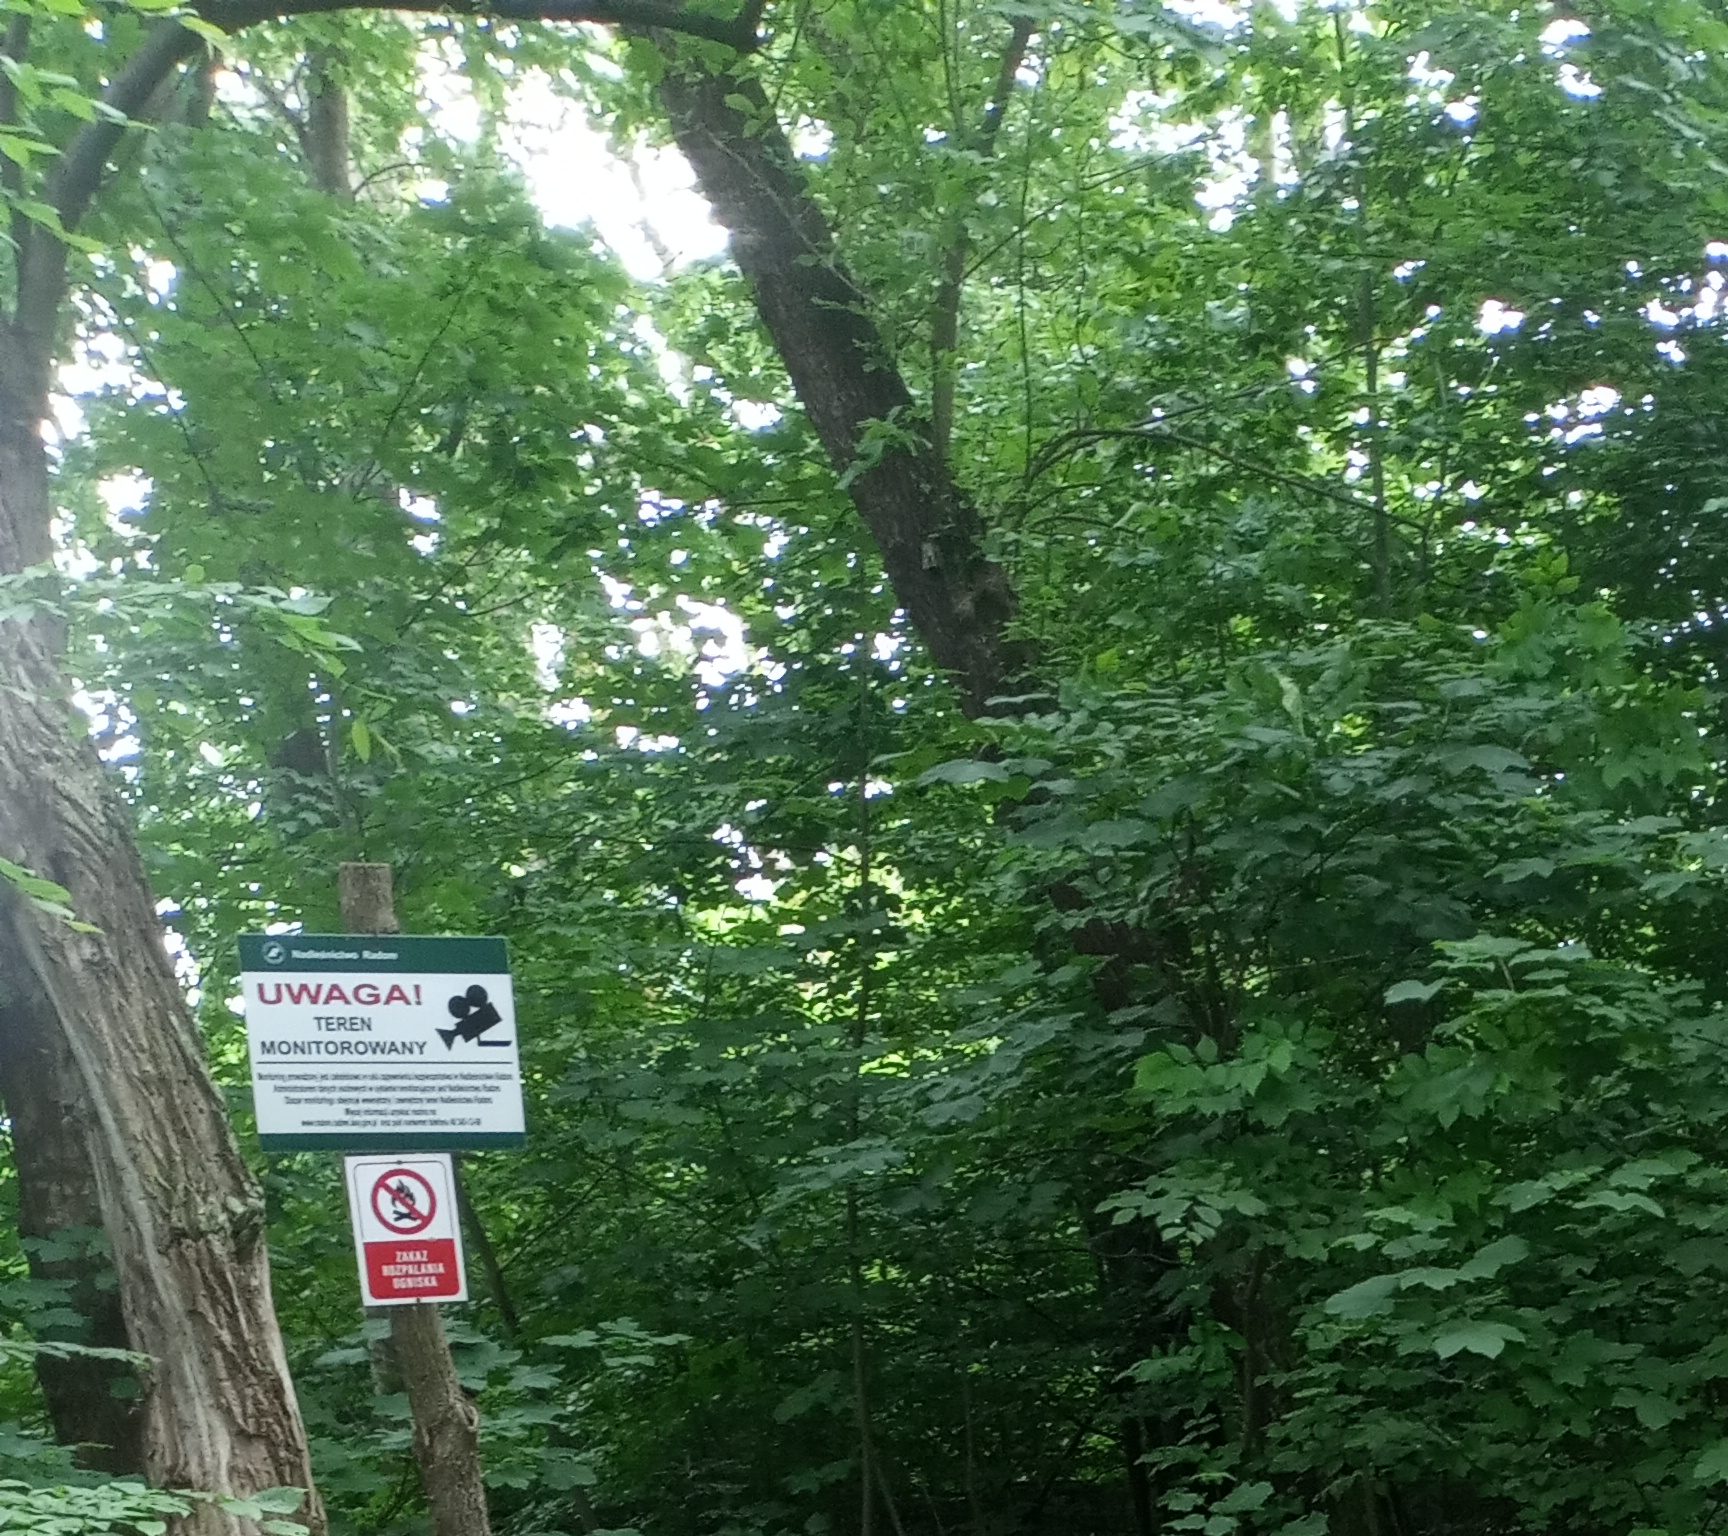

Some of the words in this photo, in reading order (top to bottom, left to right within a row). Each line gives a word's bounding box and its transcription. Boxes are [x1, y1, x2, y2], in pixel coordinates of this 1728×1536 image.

[257, 983, 423, 1006] UWAGA!
[313, 1016, 372, 1032] TEREN
[261, 1040, 427, 1056] MONITOROWANY
[395, 1250, 428, 1262] ZAKAZ
